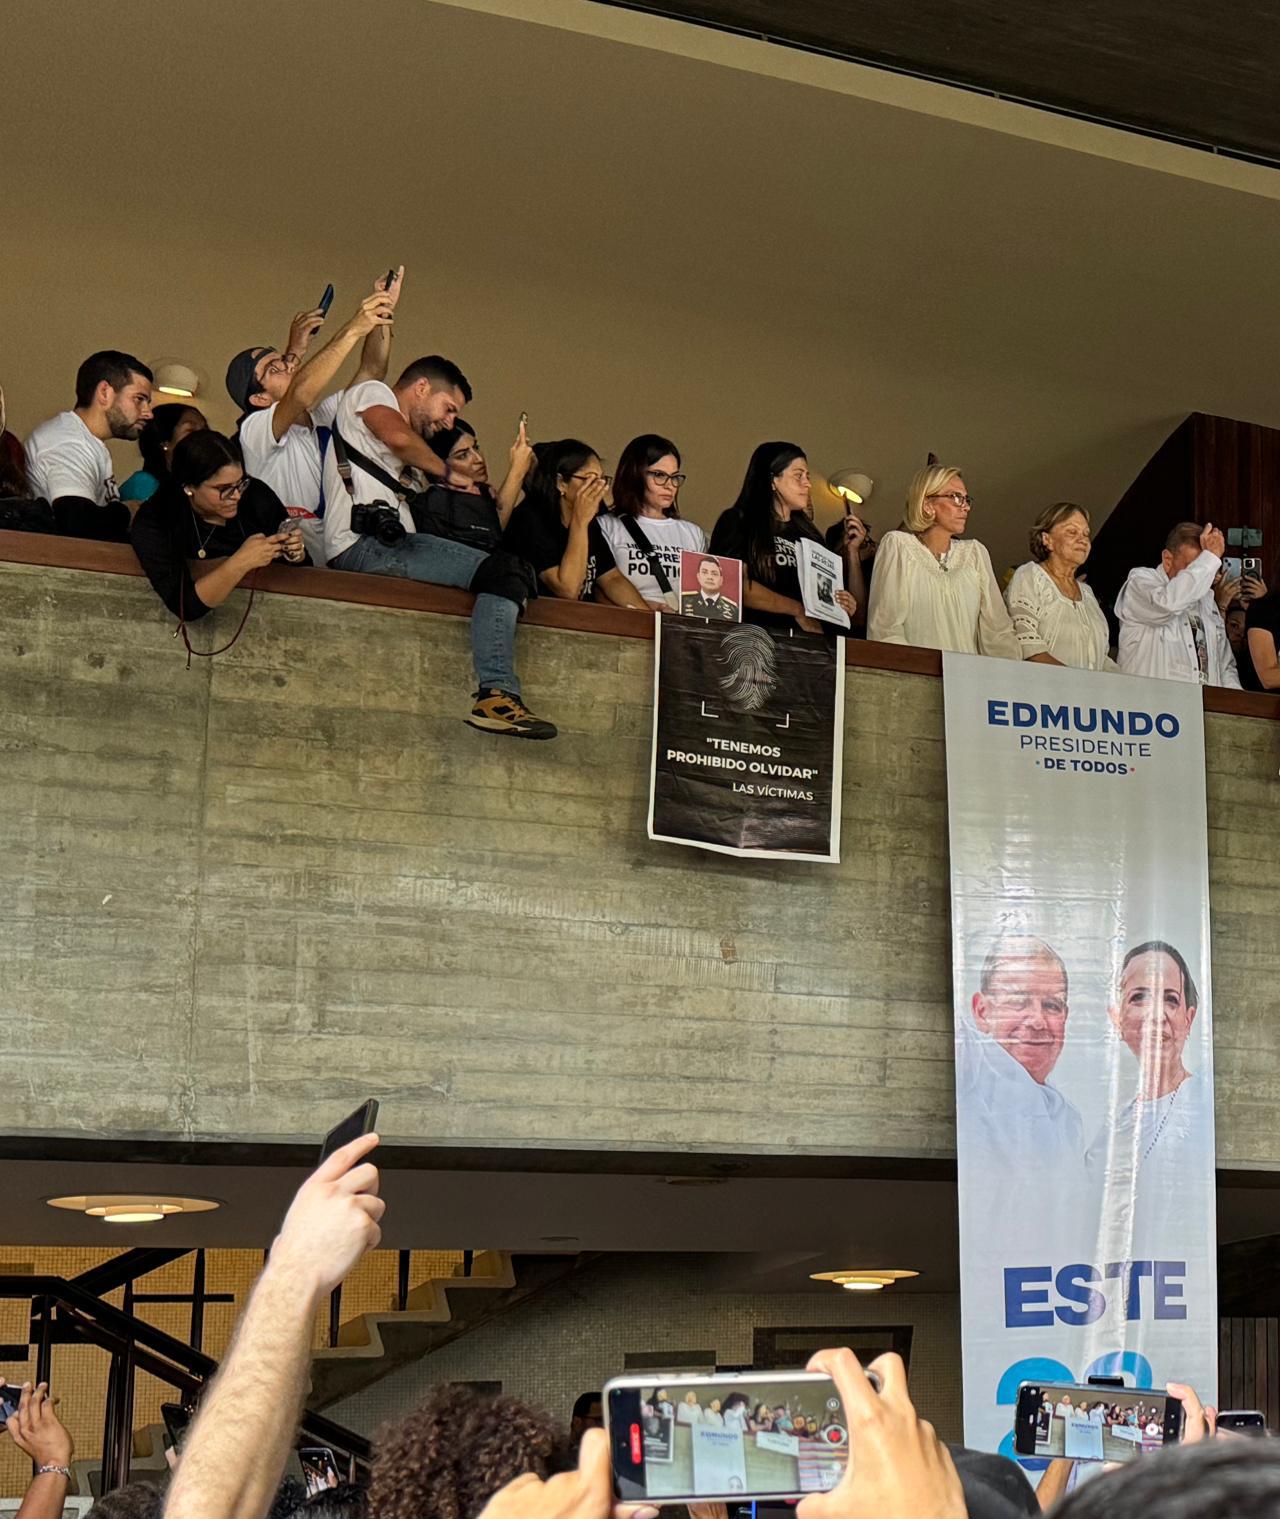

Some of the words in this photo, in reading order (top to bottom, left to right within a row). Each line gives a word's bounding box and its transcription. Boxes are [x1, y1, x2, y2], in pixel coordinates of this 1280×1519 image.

[628, 562, 681, 578] POLTI
[987, 699, 1181, 739] EDMUNDO
[706, 737, 781, 758] "TENEMOS
[1020, 735, 1152, 757] PRESIDENTE
[666, 749, 747, 771] PROHIBIDO
[749, 762, 818, 780] OLVIDAR"
[1043, 757, 1066, 770] DE
[1070, 759, 1128, 775] TODOS
[732, 782, 754, 795] LAS
[757, 784, 814, 801] VÍCTIMAS
[1003, 1260, 1188, 1329] ESTE
